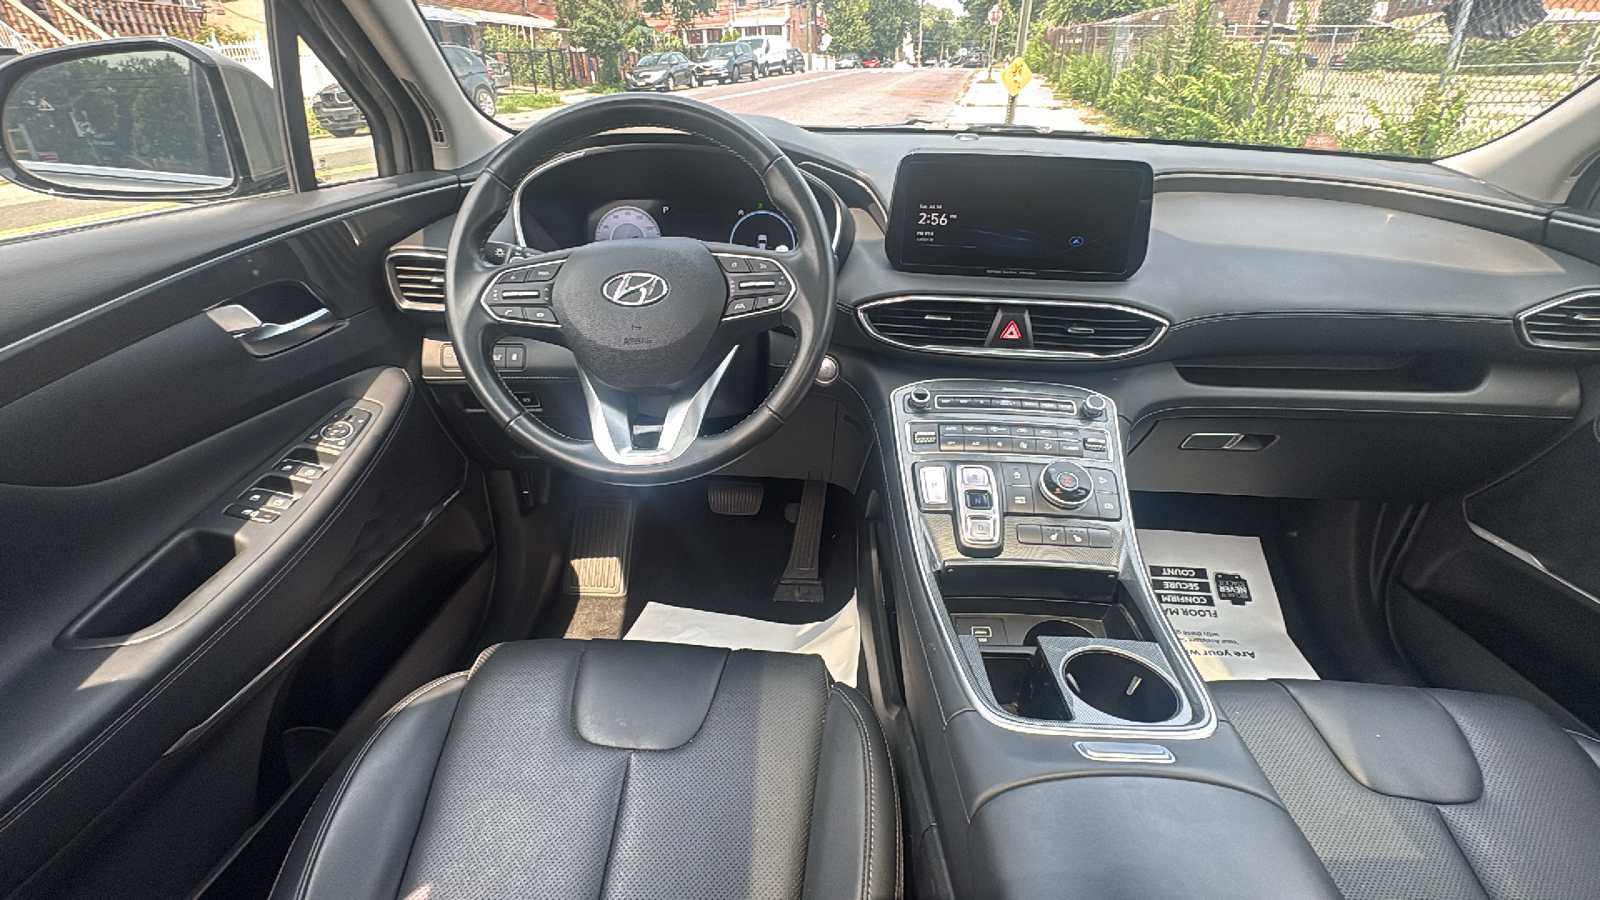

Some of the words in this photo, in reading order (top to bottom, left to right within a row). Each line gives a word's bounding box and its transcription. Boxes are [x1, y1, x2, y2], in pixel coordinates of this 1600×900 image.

[662, 206, 669, 214] P
[917, 212, 948, 226] 2:56
[1161, 568, 1196, 577] COUNT
[1163, 581, 1200, 591] SECURE
[1219, 586, 1248, 594] NEVER
[1161, 594, 1208, 604] CONFIRM
[1181, 608, 1218, 618] FLOOR
[1203, 649, 1233, 658] your
[1234, 651, 1256, 659] Are
